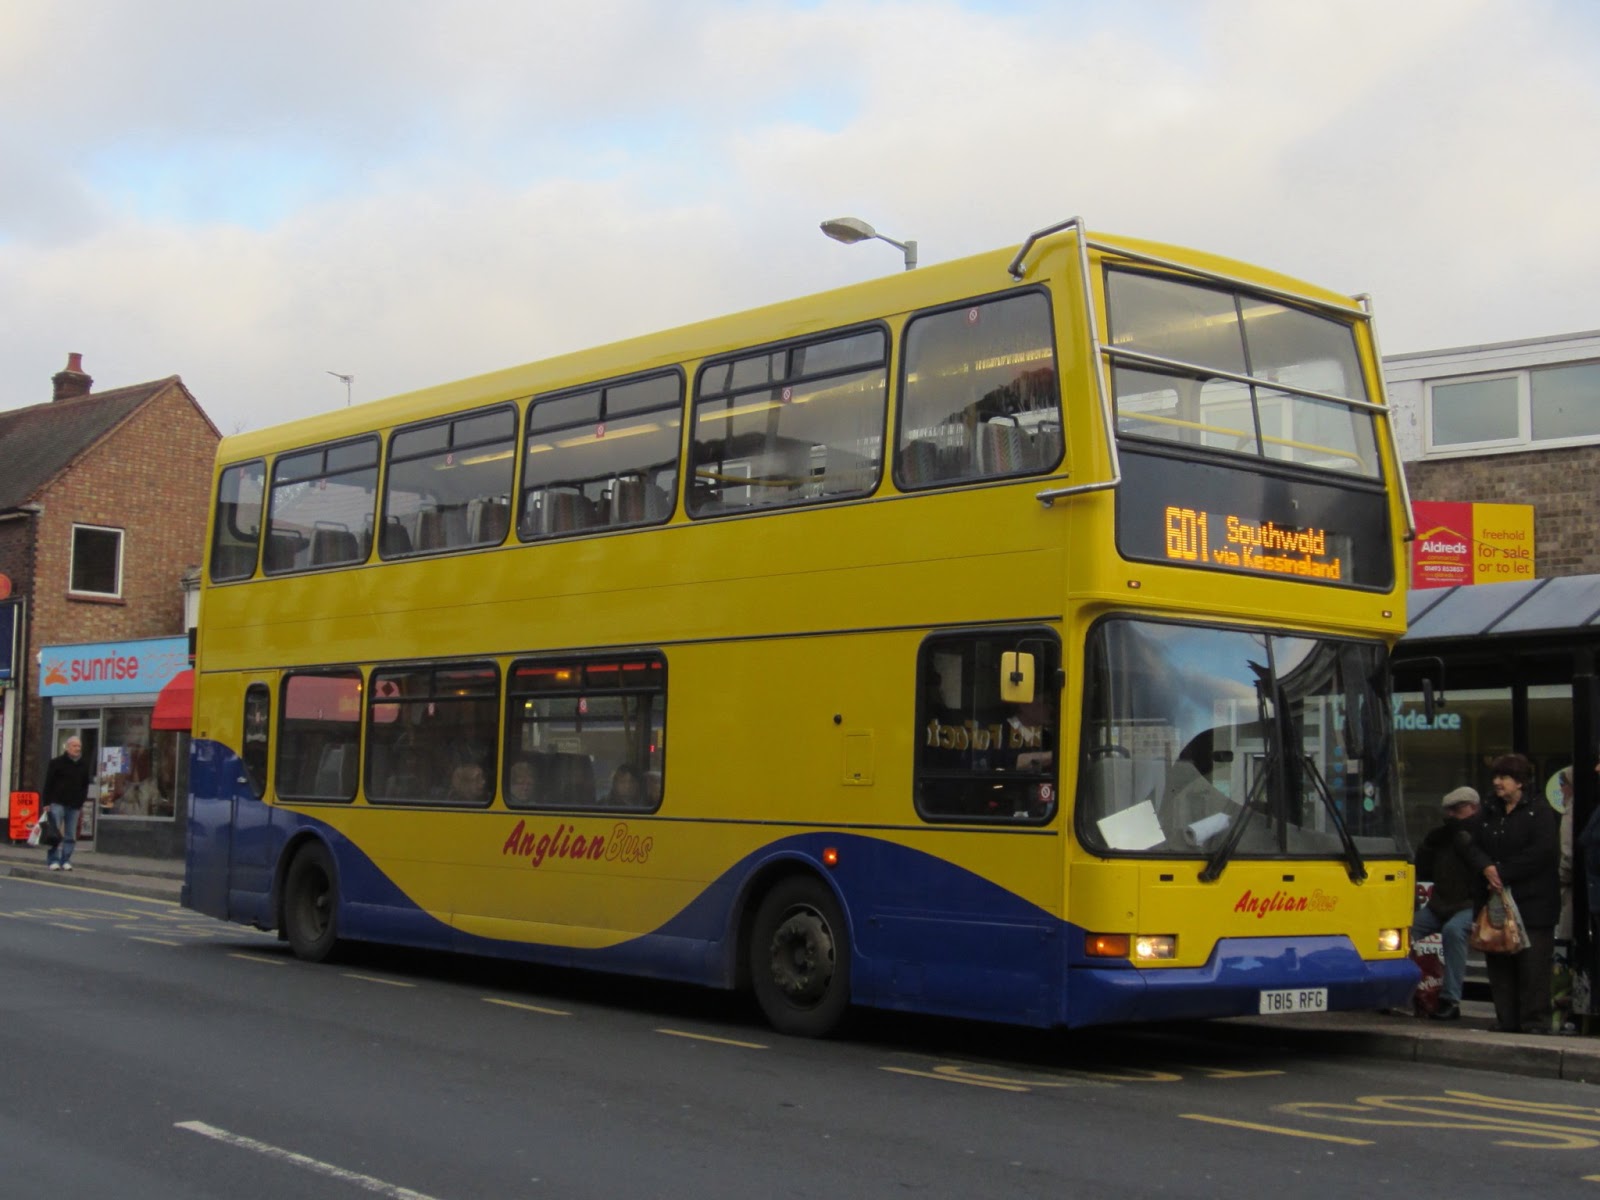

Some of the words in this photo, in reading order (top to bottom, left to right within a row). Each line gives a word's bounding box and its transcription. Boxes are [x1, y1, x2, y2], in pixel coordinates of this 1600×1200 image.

[1165, 506, 1209, 562] 601
[1226, 515, 1326, 555] Southwold
[1482, 528, 1525, 541] freehold
[1213, 546, 1240, 566] via
[1420, 541, 1467, 554] Aldreds
[1478, 543, 1497, 558] for
[1503, 546, 1530, 559] sale
[1478, 564, 1493, 573] or
[1496, 563, 1511, 574] to
[1513, 561, 1530, 574] let
[70, 650, 139, 682] sunrise
[1266, 993, 1294, 1011] T815
[1299, 991, 1323, 1008] RFG
